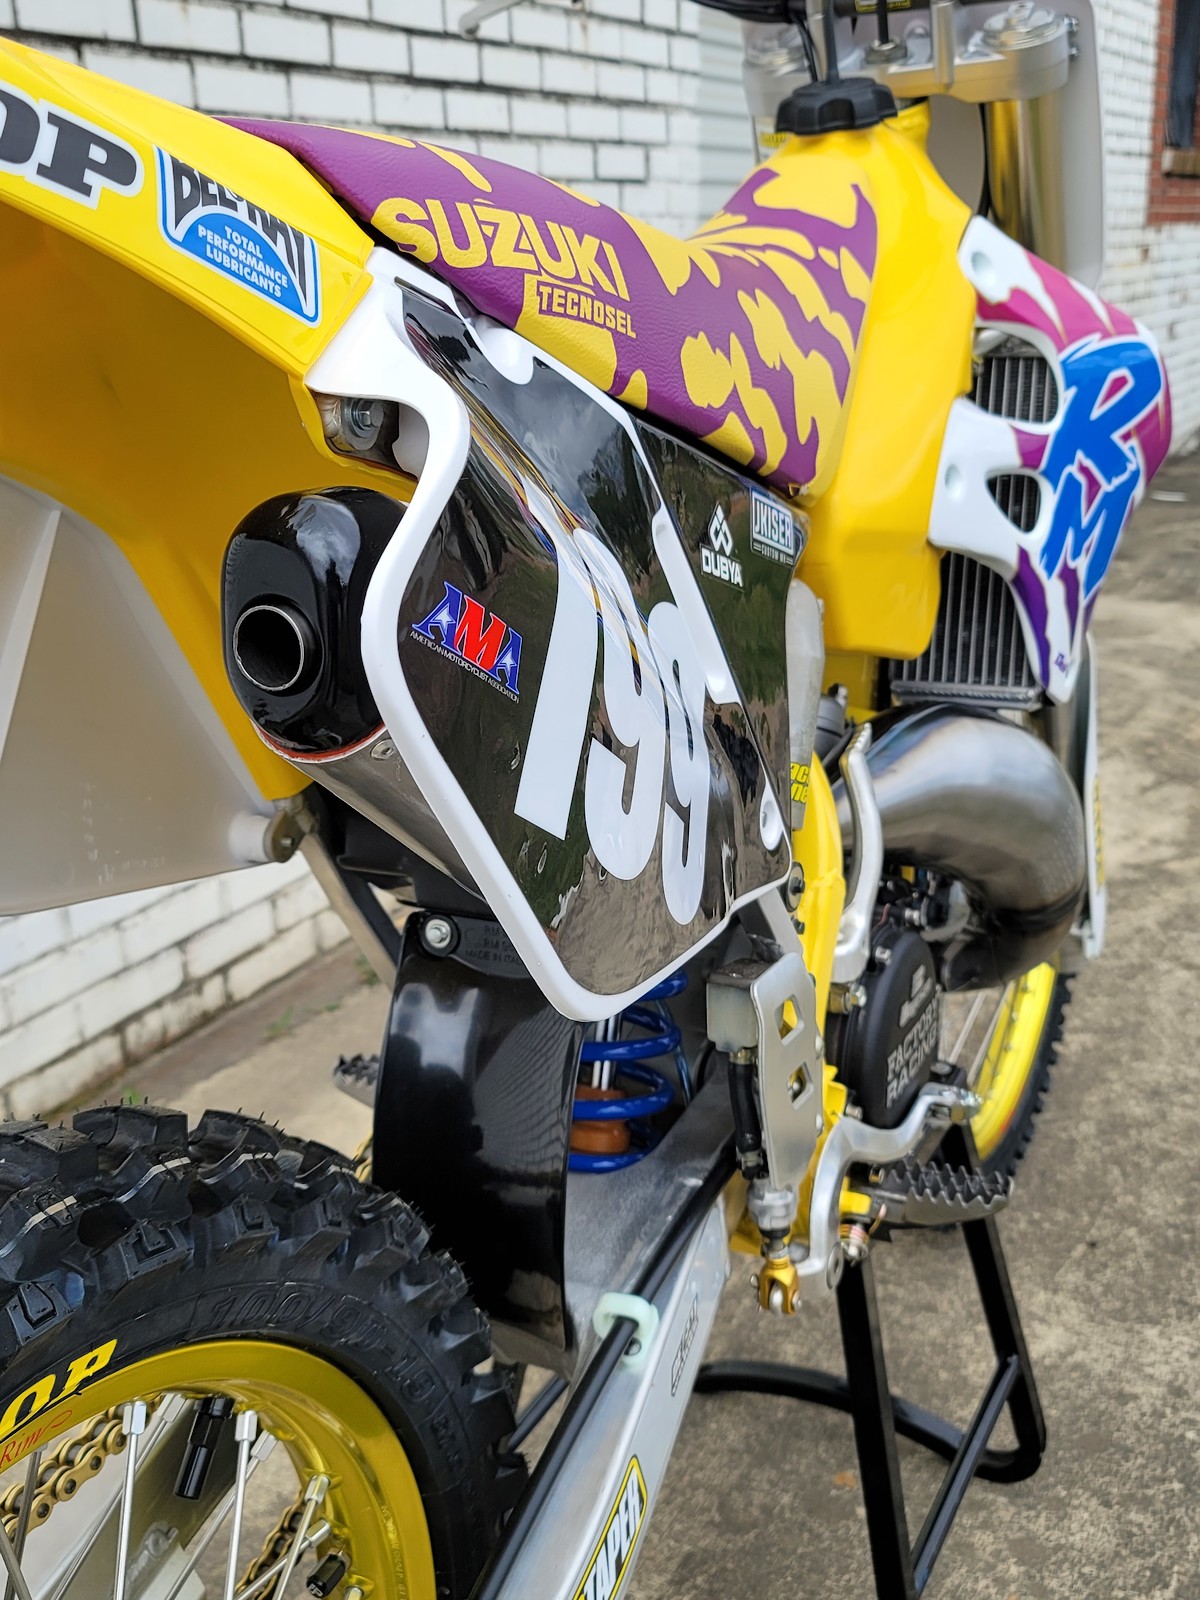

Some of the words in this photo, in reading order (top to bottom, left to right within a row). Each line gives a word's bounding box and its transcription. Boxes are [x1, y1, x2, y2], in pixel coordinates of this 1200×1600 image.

[197, 224, 289, 289] PERFORMANCE
[205, 244, 282, 298] LUBRICANTS
[224, 225, 264, 260] TOTAL
[371, 197, 630, 302] SUZUKI
[538, 285, 637, 339] TECNOSEL
[754, 498, 792, 549] JKISER
[701, 547, 743, 588] DUBYA
[410, 631, 445, 656] AMERICAN
[443, 651, 490, 682] MOTORCYCLIST
[487, 677, 520, 704] ASSOCIATION
[411, 581, 523, 695] AMA
[886, 994, 940, 1082] FACTORY
[886, 1020, 939, 1109] RACING
